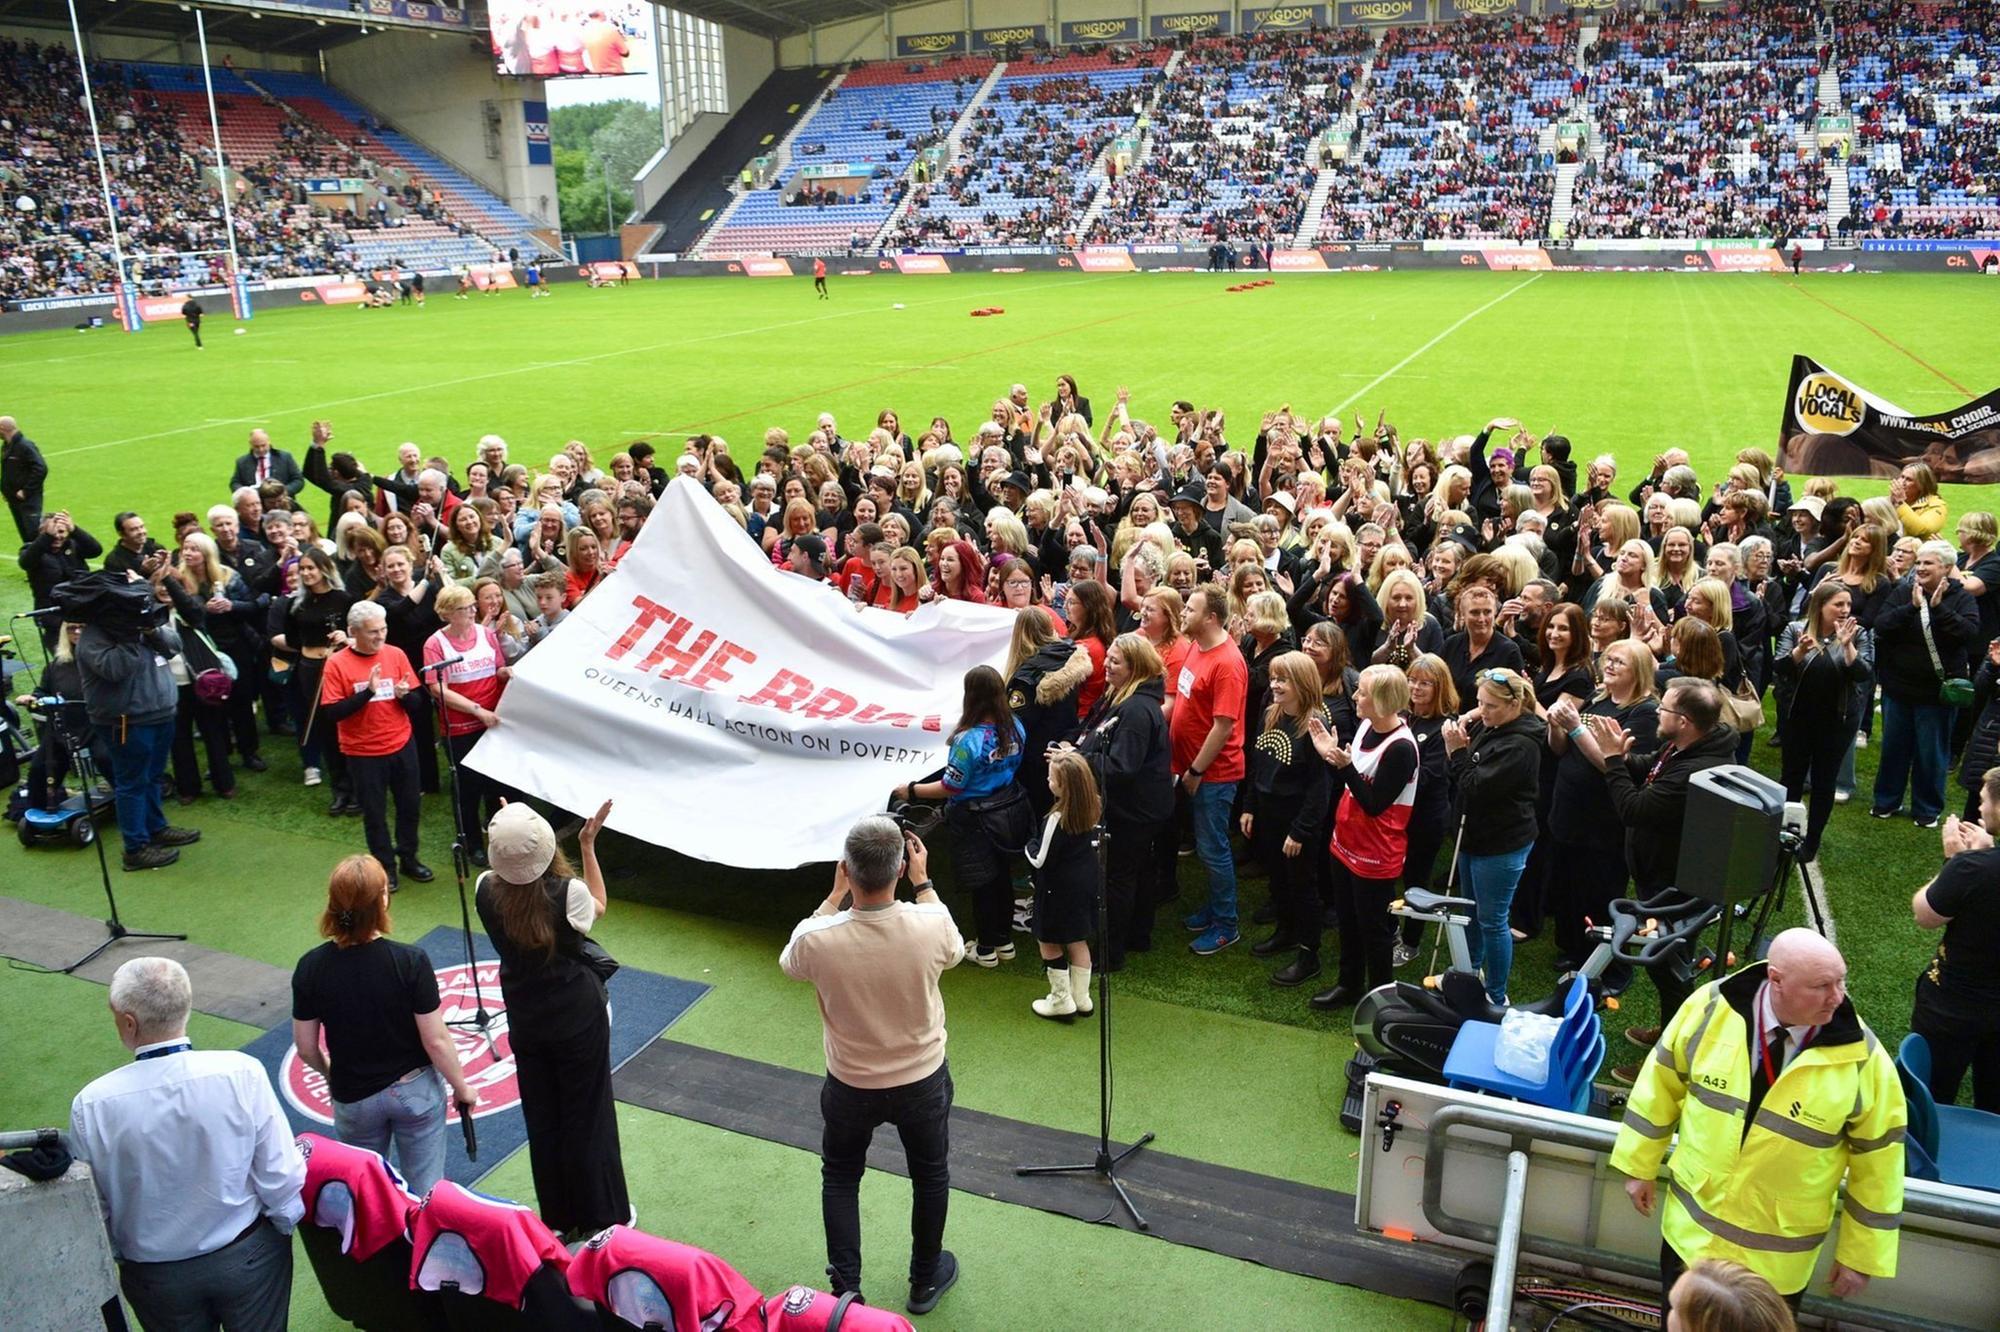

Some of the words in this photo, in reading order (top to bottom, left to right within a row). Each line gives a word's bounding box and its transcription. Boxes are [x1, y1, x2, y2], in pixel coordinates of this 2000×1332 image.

[1254, 7, 1313, 22] KINGDOM
[1351, 1, 1412, 15] KINGDOM
[1072, 21, 1126, 35] KINGDOM
[1162, 14, 1219, 28] KINGDOM
[906, 34, 956, 48] KINGDOM
[983, 28, 1034, 41] KINGDOM
[965, 248, 982, 256] LOCH
[21, 302, 45, 312] LOCH
[46, 299, 82, 310] LOMOND
[1806, 380, 1858, 410] LOCAL
[1799, 397, 1861, 423] VOCALS
[604, 594, 758, 691] THE
[584, 667, 663, 708] QUEENS
[669, 701, 716, 727] HALL
[725, 719, 793, 745] ACTION
[801, 734, 830, 752] ON
[840, 739, 935, 765] POVERTY
[1703, 1075, 1728, 1090] A43
